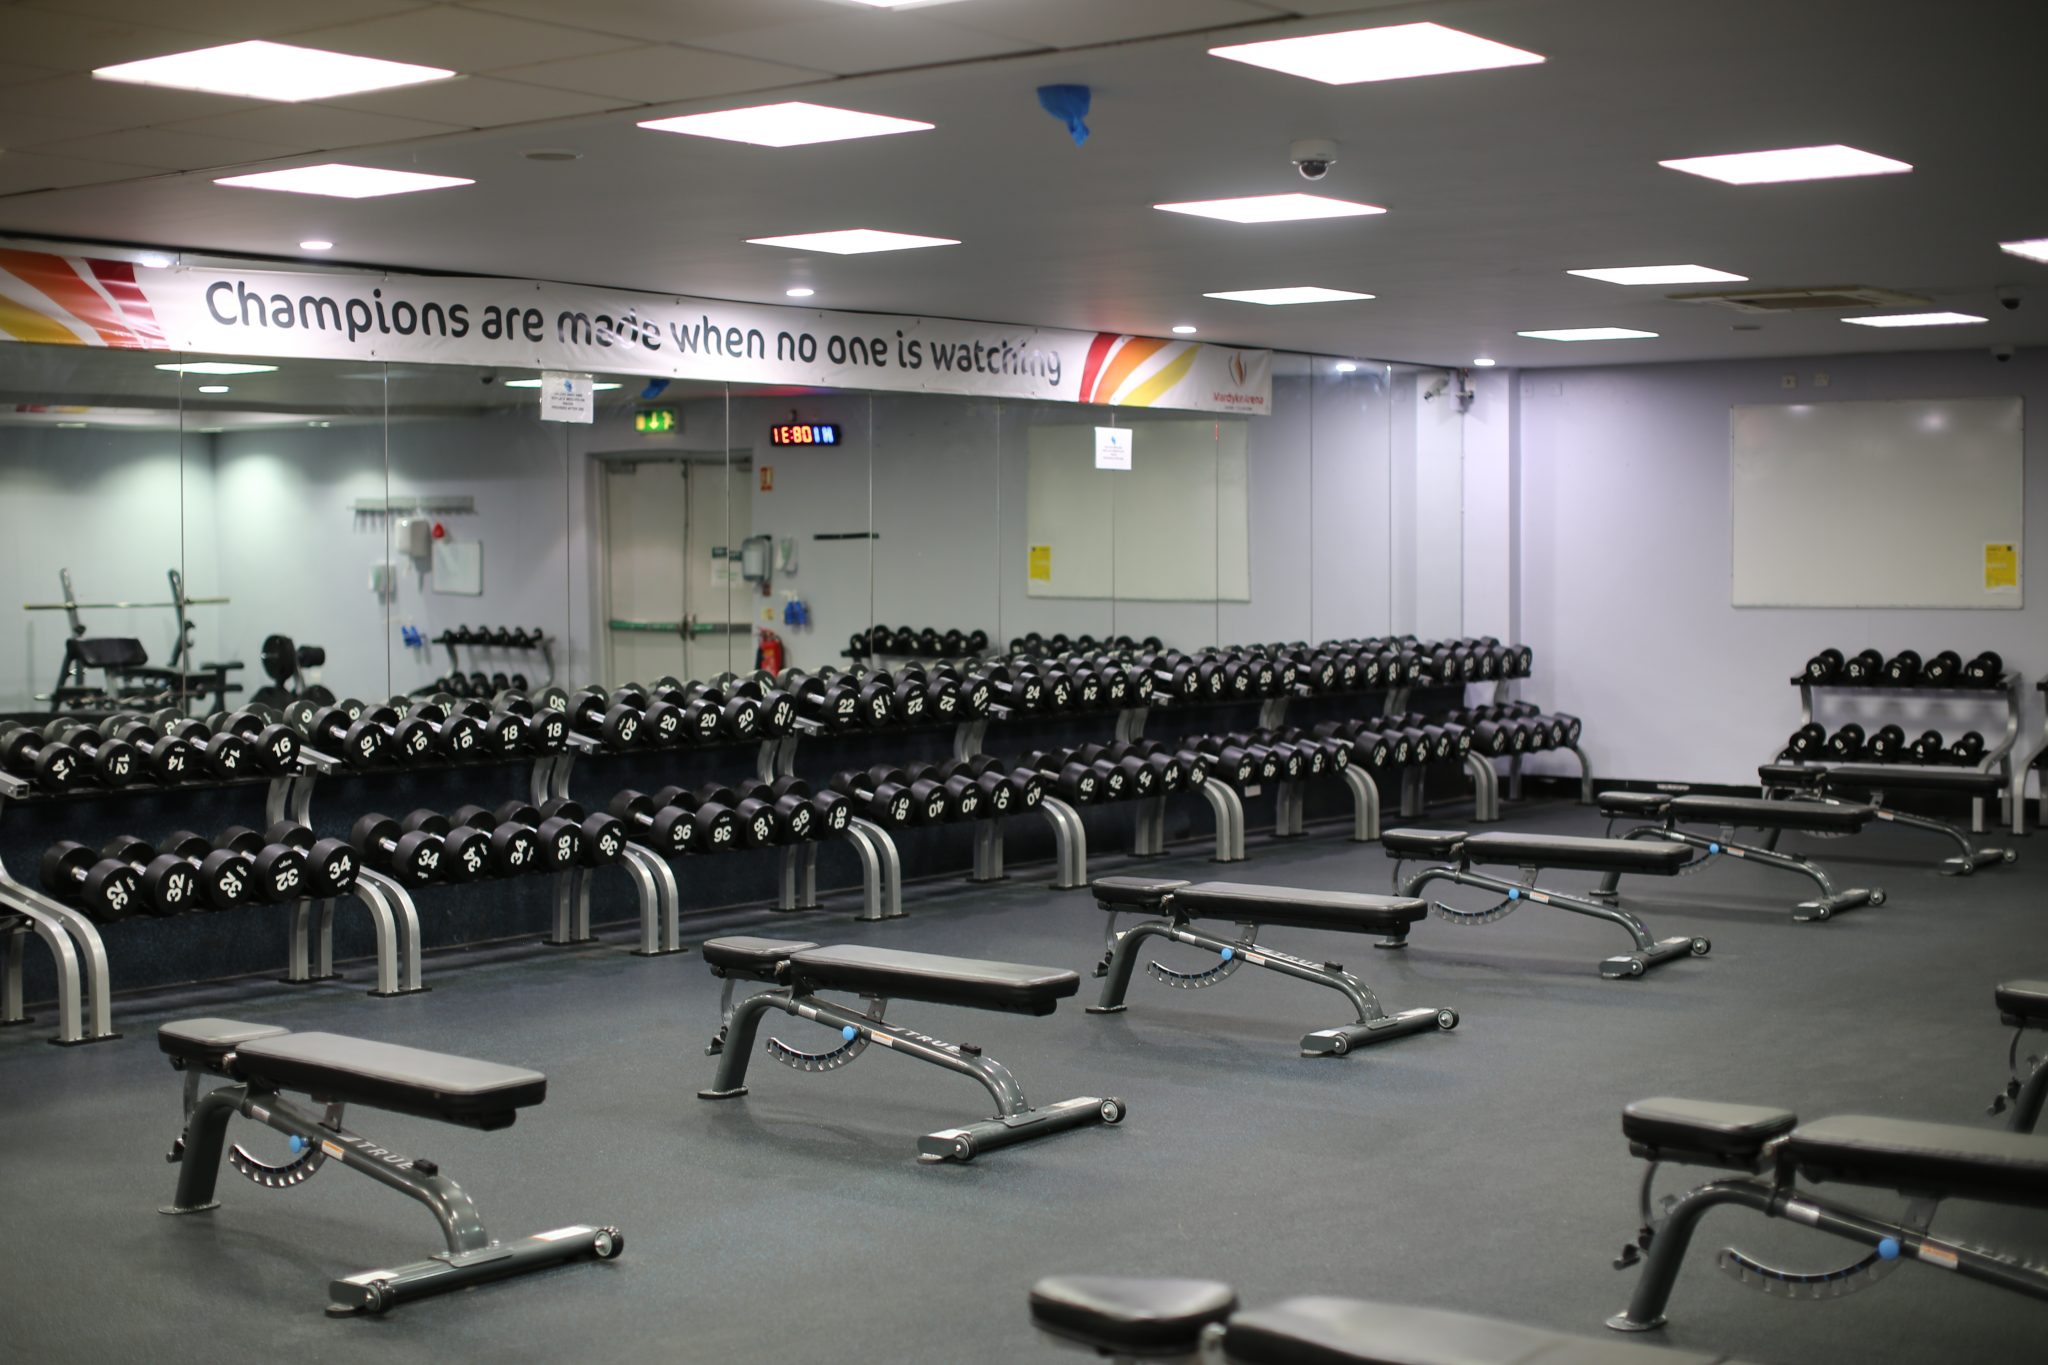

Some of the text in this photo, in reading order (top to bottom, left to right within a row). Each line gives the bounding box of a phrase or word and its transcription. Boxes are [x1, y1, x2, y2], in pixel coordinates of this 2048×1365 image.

[205, 281, 1061, 386] Champions are made when no one is watching
[1260, 670, 1272, 684] 26
[1285, 668, 1295, 683] 26
[1811, 664, 1822, 677] 10
[1850, 664, 1859, 677] 10
[1933, 667, 1942, 676] 8
[1111, 683, 1125, 698] 24
[1140, 678, 1153, 698] 24
[1188, 672, 1198, 692] 24
[973, 686, 989, 706] 22
[1026, 686, 1040, 699] 24
[1055, 684, 1068, 705] 24
[1084, 687, 1098, 700] 24
[838, 698, 855, 713] 22
[873, 695, 886, 718] 22
[908, 697, 924, 715] 22
[940, 695, 956, 711] 22
[660, 714, 677, 731] 20
[701, 714, 716, 727] 20
[738, 709, 754, 728] 20
[775, 702, 789, 726] 22
[460, 726, 472, 748] 16
[502, 725, 518, 740] 18
[547, 723, 562, 738] 18
[621, 717, 637, 741] 20
[272, 736, 291, 758] 16
[361, 735, 375, 758] 16
[412, 729, 427, 750] 16
[115, 753, 130, 775] 12
[168, 755, 185, 771] 14
[224, 749, 240, 769] 14
[1313, 754, 1322, 772] 50
[52, 759, 69, 781] 14
[1138, 771, 1151, 787] 44
[1164, 766, 1178, 782] 44
[1239, 766, 1251, 780] 46
[1080, 778, 1094, 792] 42
[1109, 774, 1123, 789] 42
[962, 797, 978, 813] 40
[998, 787, 1009, 809] 40
[1027, 787, 1041, 805] 40
[834, 806, 846, 829] 38
[896, 798, 908, 820] 38
[929, 800, 944, 817] 40
[754, 817, 768, 840] 38
[792, 809, 810, 831] 38
[673, 825, 691, 840] 36
[713, 826, 732, 842] 36
[510, 840, 527, 865] 34
[557, 835, 570, 860] 36
[599, 835, 618, 856] 36
[329, 855, 350, 879] 34
[418, 849, 439, 869] 34
[463, 846, 481, 872] 34
[166, 873, 185, 902] 32
[219, 871, 243, 898] 32
[275, 868, 299, 891] 32
[106, 880, 128, 910] 32
[905, 1030, 960, 1052] TRUE
[357, 1141, 414, 1170] TRUE
